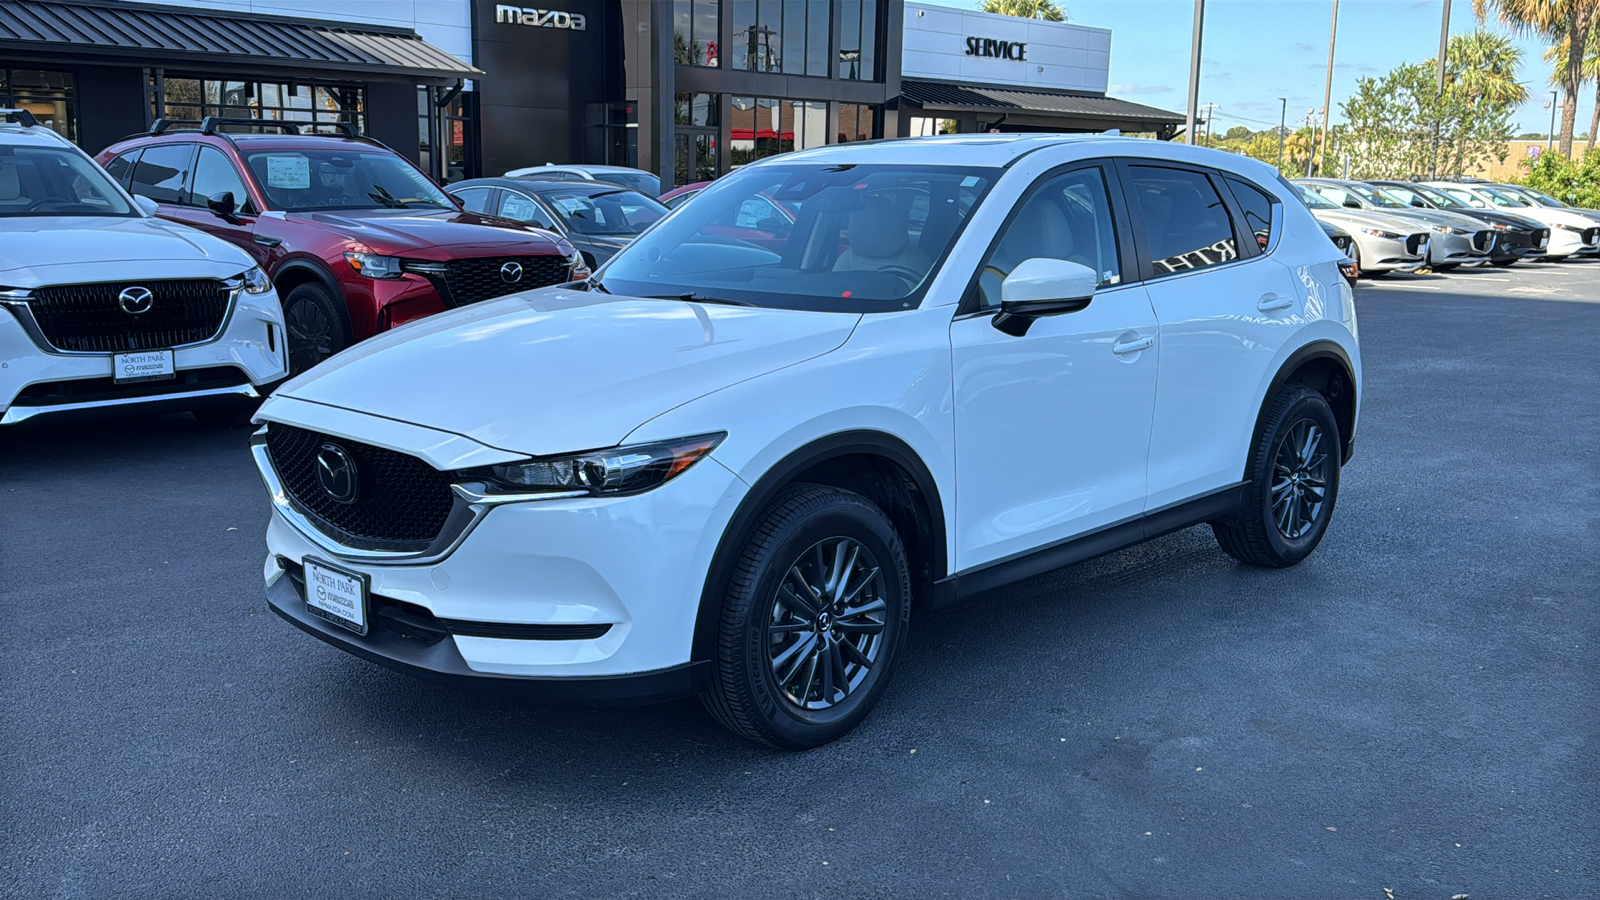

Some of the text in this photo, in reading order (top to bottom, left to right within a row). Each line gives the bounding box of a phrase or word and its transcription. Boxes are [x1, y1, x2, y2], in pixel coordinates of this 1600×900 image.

[965, 36, 1028, 62] SERVICE
[121, 354, 165, 364] NORTH PARK
[312, 570, 355, 596] NORTH PARK
[318, 600, 354, 619] NPMAZDA.COM
[751, 629, 766, 695] MICHELIN
